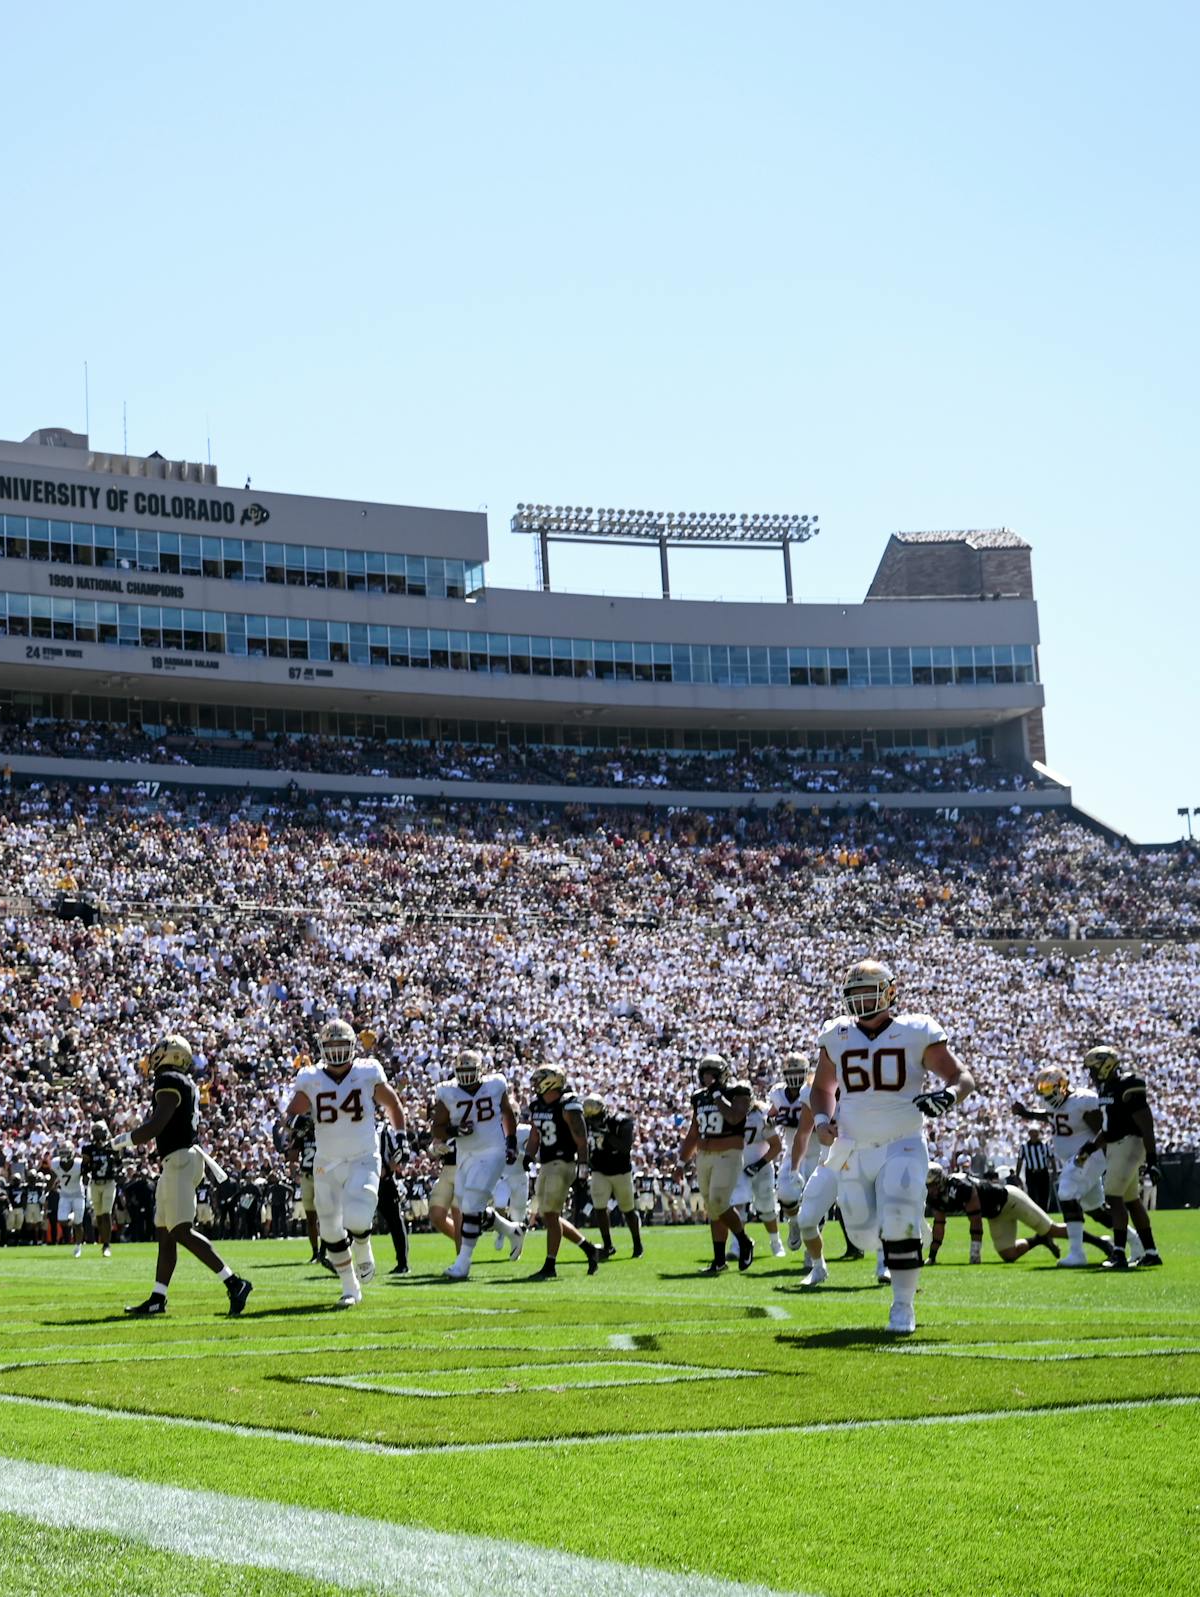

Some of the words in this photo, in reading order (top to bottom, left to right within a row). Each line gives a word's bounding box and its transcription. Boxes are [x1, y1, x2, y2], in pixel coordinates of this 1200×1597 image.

[106, 488, 128, 513] OF
[134, 492, 235, 524] COLORADO
[48, 573, 74, 588] 1990
[76, 576, 124, 593] NATIONAL
[127, 581, 185, 599] CHAMPIONS
[26, 645, 40, 659] 24
[152, 656, 163, 669] 19
[289, 666, 302, 680] 67
[841, 1048, 907, 1094] 60
[316, 1088, 364, 1124] 64
[456, 1097, 495, 1127] 78
[61, 1174, 72, 1187] 7
